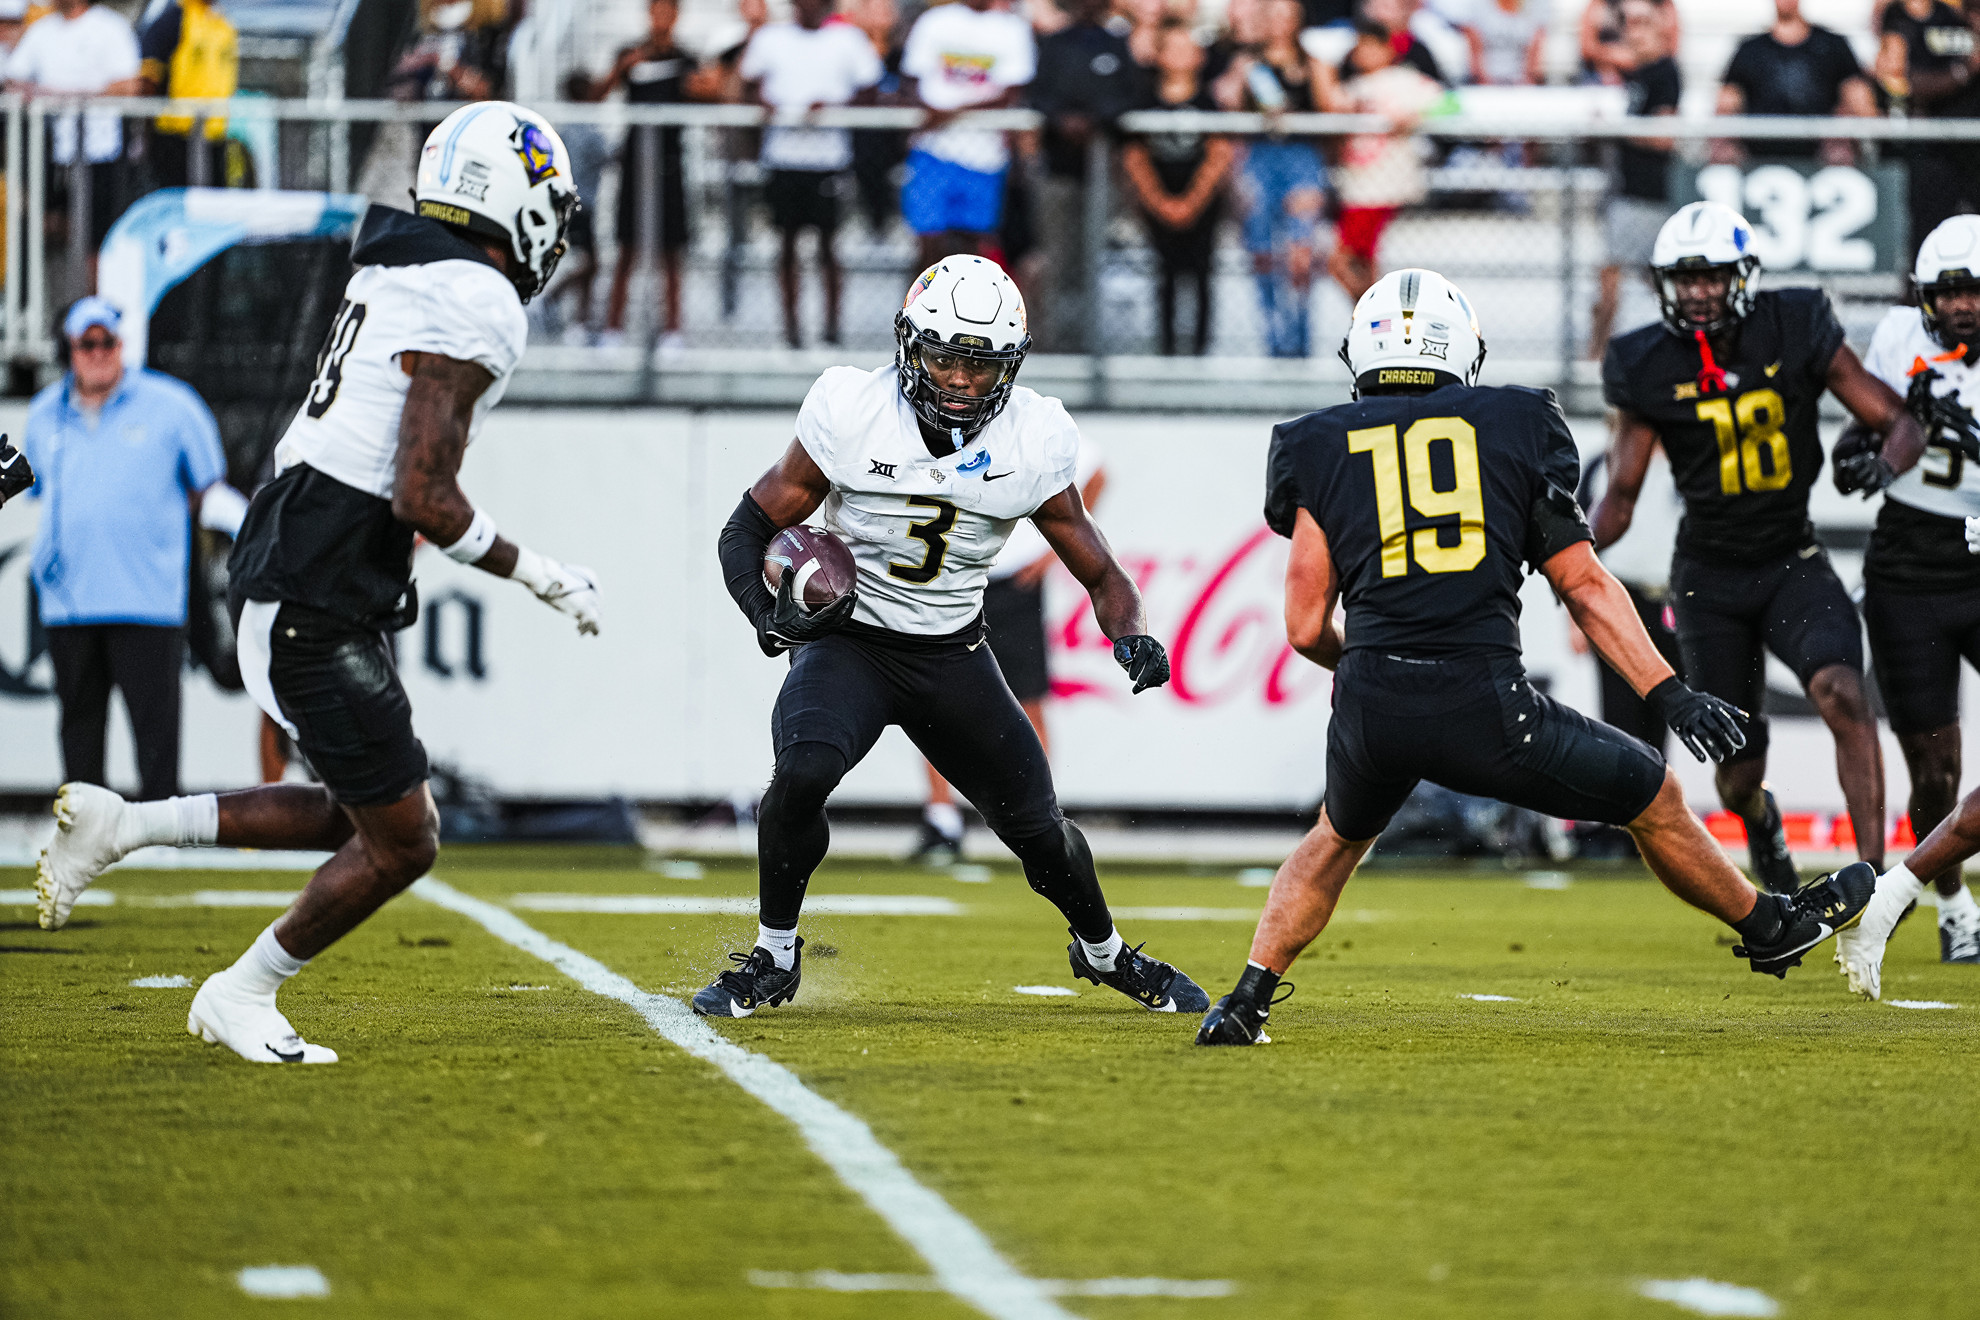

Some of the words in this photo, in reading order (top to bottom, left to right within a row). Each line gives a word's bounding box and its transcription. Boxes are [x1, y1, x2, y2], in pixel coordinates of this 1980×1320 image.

[420, 201, 471, 227] CHARGEON
[1378, 369, 1436, 385] CHARGEON
[1695, 387, 1793, 496] 18
[866, 458, 898, 482] XII
[929, 468, 947, 484] UCF
[1347, 416, 1487, 579] 19
[886, 494, 960, 586] 3
